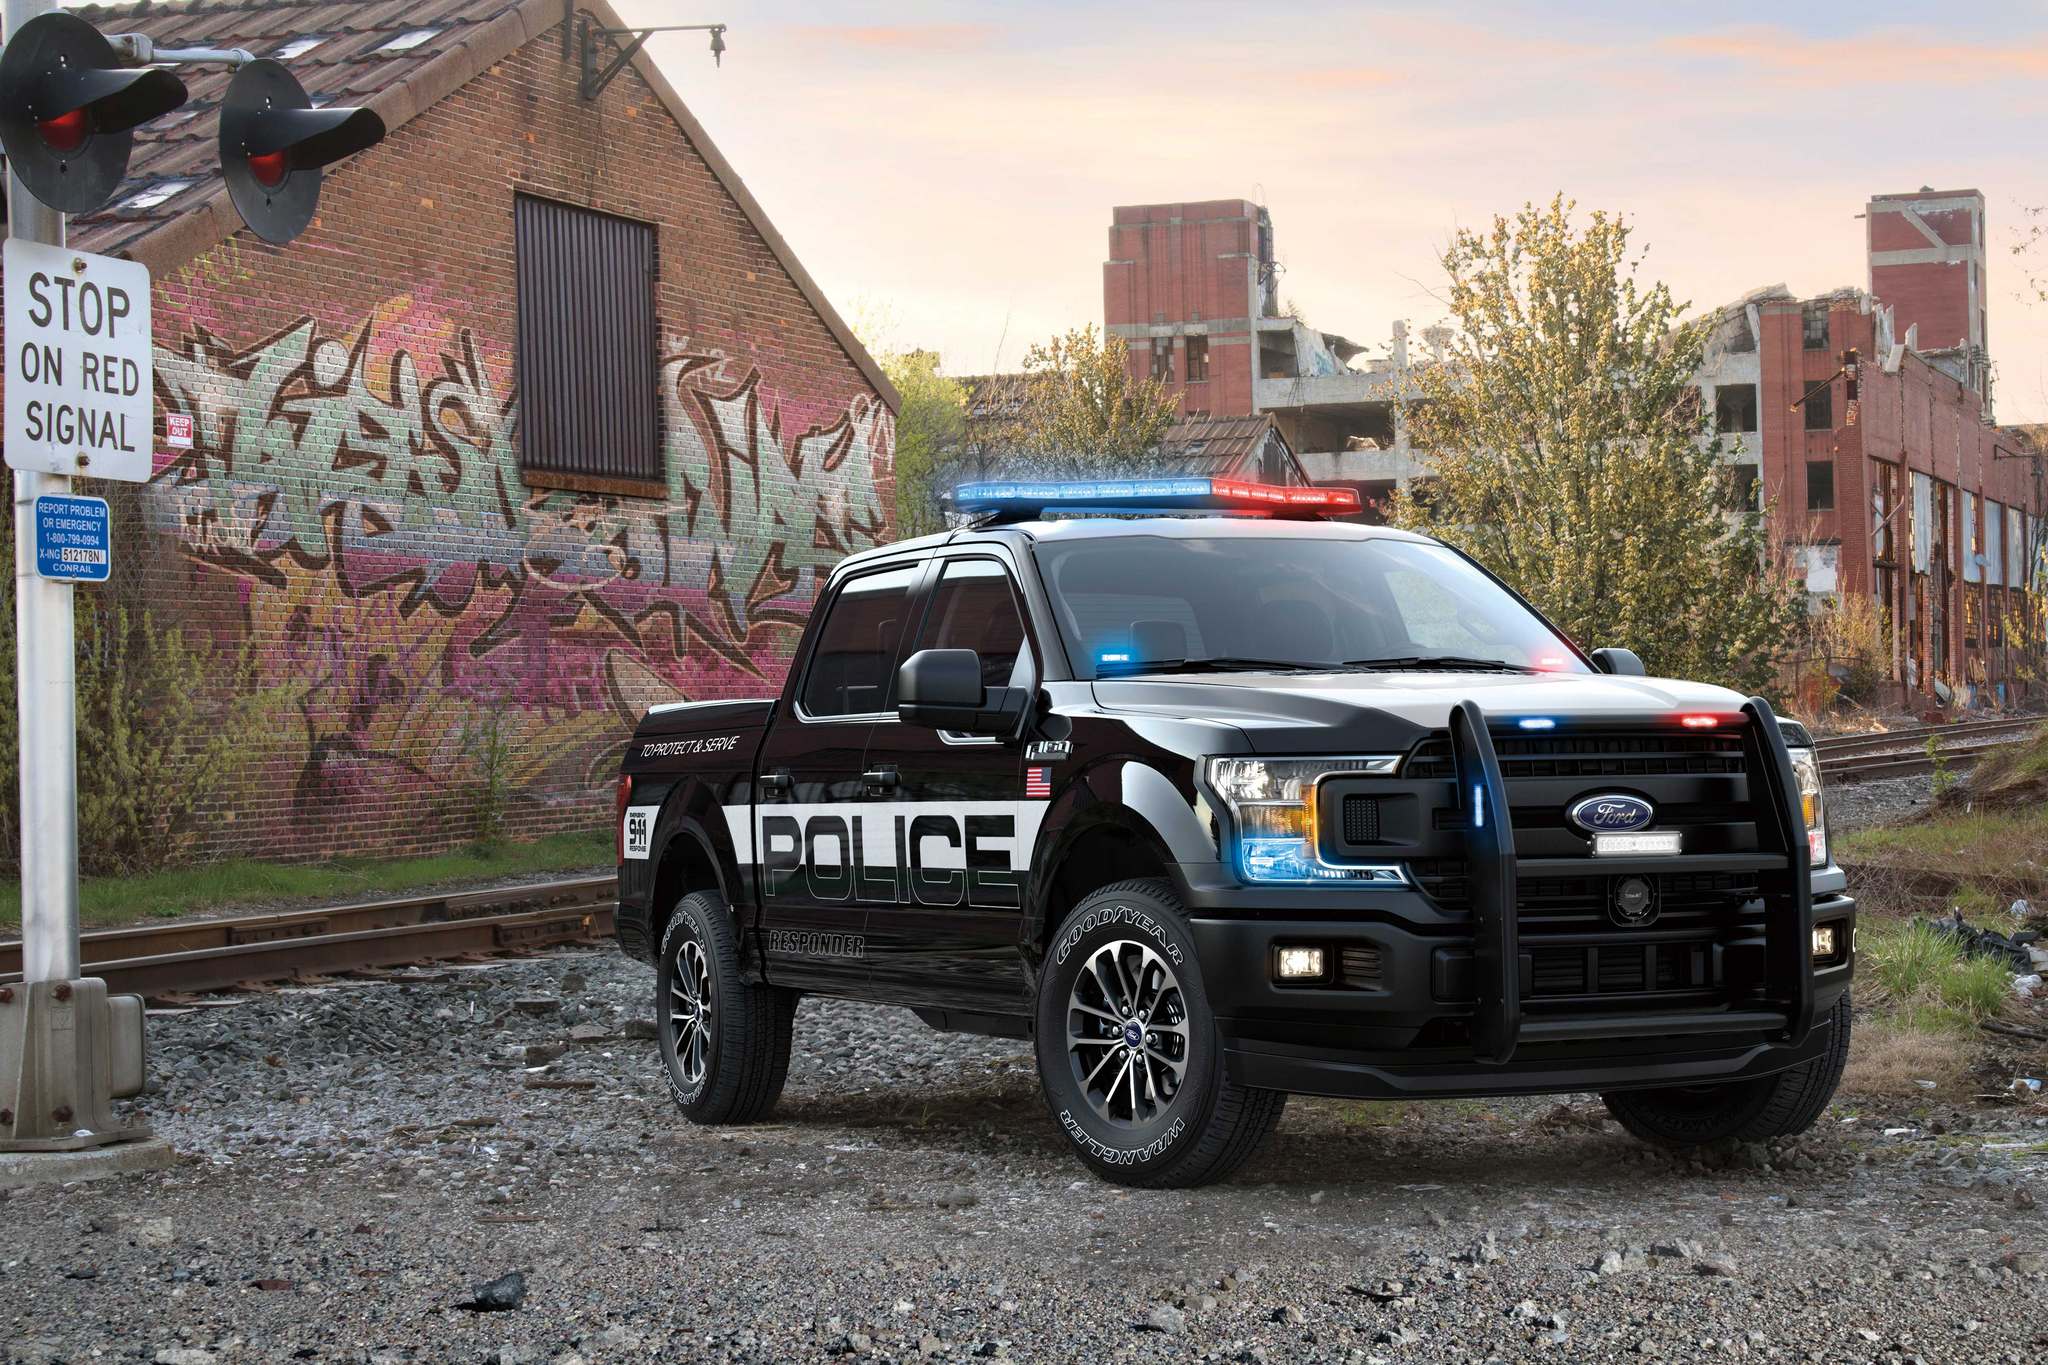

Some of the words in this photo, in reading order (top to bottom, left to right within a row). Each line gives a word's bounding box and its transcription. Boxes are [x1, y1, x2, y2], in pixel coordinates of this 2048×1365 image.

[28, 271, 131, 338] STOP
[21, 341, 62, 386] ON
[82, 352, 139, 397] RED
[25, 400, 136, 452] SIGNAL
[169, 417, 190, 427] KEEP
[171, 427, 188, 437] OUT
[38, 502, 69, 514] REPORT
[70, 505, 106, 518] PROBLEM
[42, 517, 54, 529] OR
[55, 518, 101, 532] EMERGENCY
[39, 547, 61, 560] X-ING
[63, 548, 100, 562] 512178N
[52, 563, 94, 574] CONRAIL
[640, 743, 655, 757] TO
[650, 740, 697, 757] PROTECT
[692, 739, 704, 753] &
[701, 735, 741, 753] SERVE
[1594, 803, 1637, 824] Ford
[762, 814, 1021, 910] POLICE
[768, 929, 865, 959] RESPONDER
[1056, 905, 1184, 966] GOODYEAR
[1060, 1109, 1186, 1165] WRANGLER
